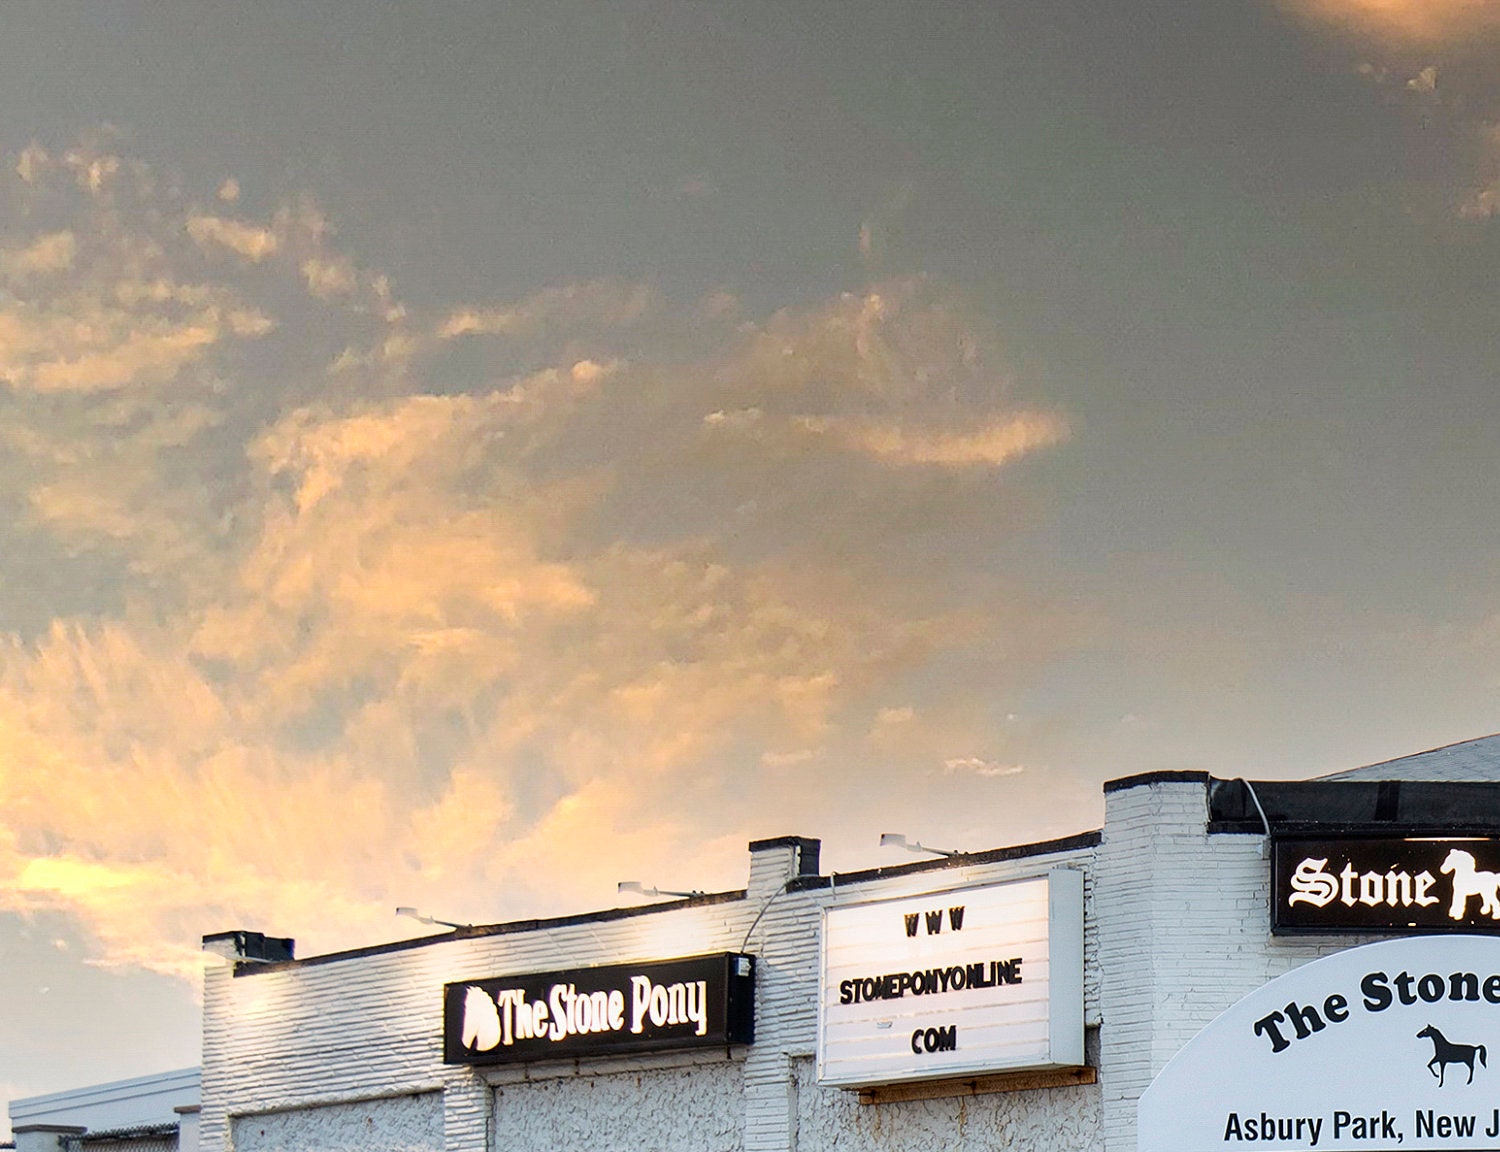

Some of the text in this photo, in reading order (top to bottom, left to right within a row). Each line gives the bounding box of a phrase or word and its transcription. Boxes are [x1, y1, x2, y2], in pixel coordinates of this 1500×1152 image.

[1287, 857, 1440, 908] Stone
[839, 957, 1023, 1005] STONEPONYONLINE
[498, 974, 708, 1046] The Stone Pony
[1253, 993, 1350, 1054] The
[910, 1024, 957, 1055] COM
[1224, 1112, 1323, 1147] Asbury
[1333, 1111, 1404, 1144] Park,
[1414, 1109, 1475, 1139] New
